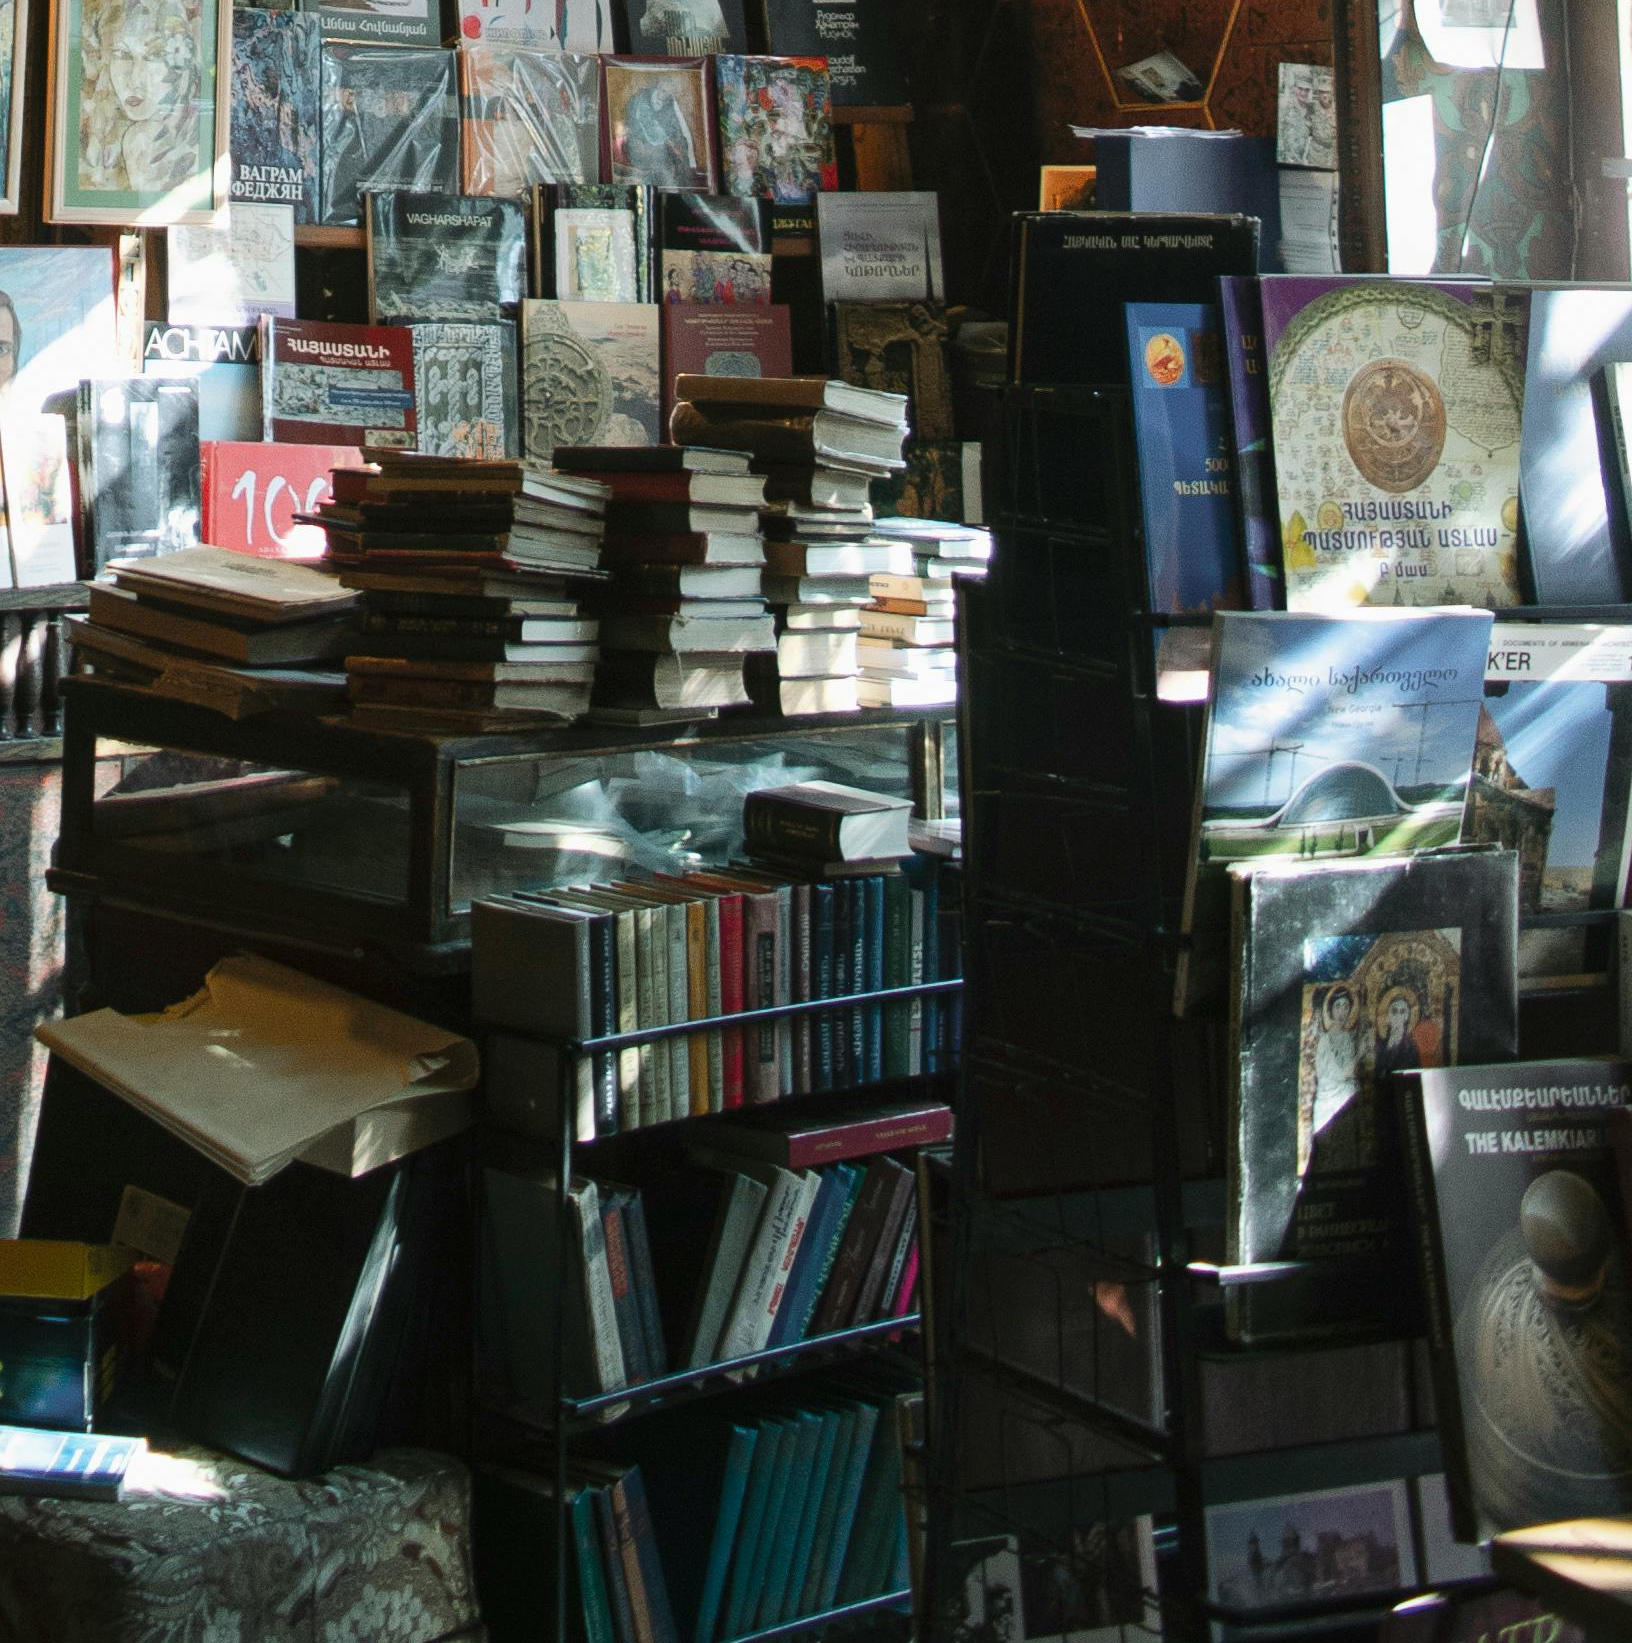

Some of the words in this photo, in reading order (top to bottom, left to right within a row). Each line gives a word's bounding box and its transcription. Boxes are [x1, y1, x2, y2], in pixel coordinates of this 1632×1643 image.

[321, 17, 356, 32] Աննա
[239, 164, 303, 184] ВАГРАМ
[230, 180, 303, 201] ФЕДЖЯН
[406, 213, 493, 228] VAGHARSHAPAT
[287, 338, 391, 358] ՀԱՅԱՍՏԱՆԻ
[1204, 458, 1229, 472] 500
[1343, 501, 1452, 521] ՀԱՅԱՍՏԱՆԻ
[1303, 529, 1432, 551] ՊԱՏՄՈՒԹՅԱՆ
[1438, 527, 1498, 549] ԱՏԼԱՍ
[1395, 561, 1428, 578] մաս
[1251, 667, 1320, 694] ახალი
[1329, 665, 1458, 694] საქართველო
[1349, 702, 1382, 715] Georgia
[1464, 1131, 1499, 1155] THE
